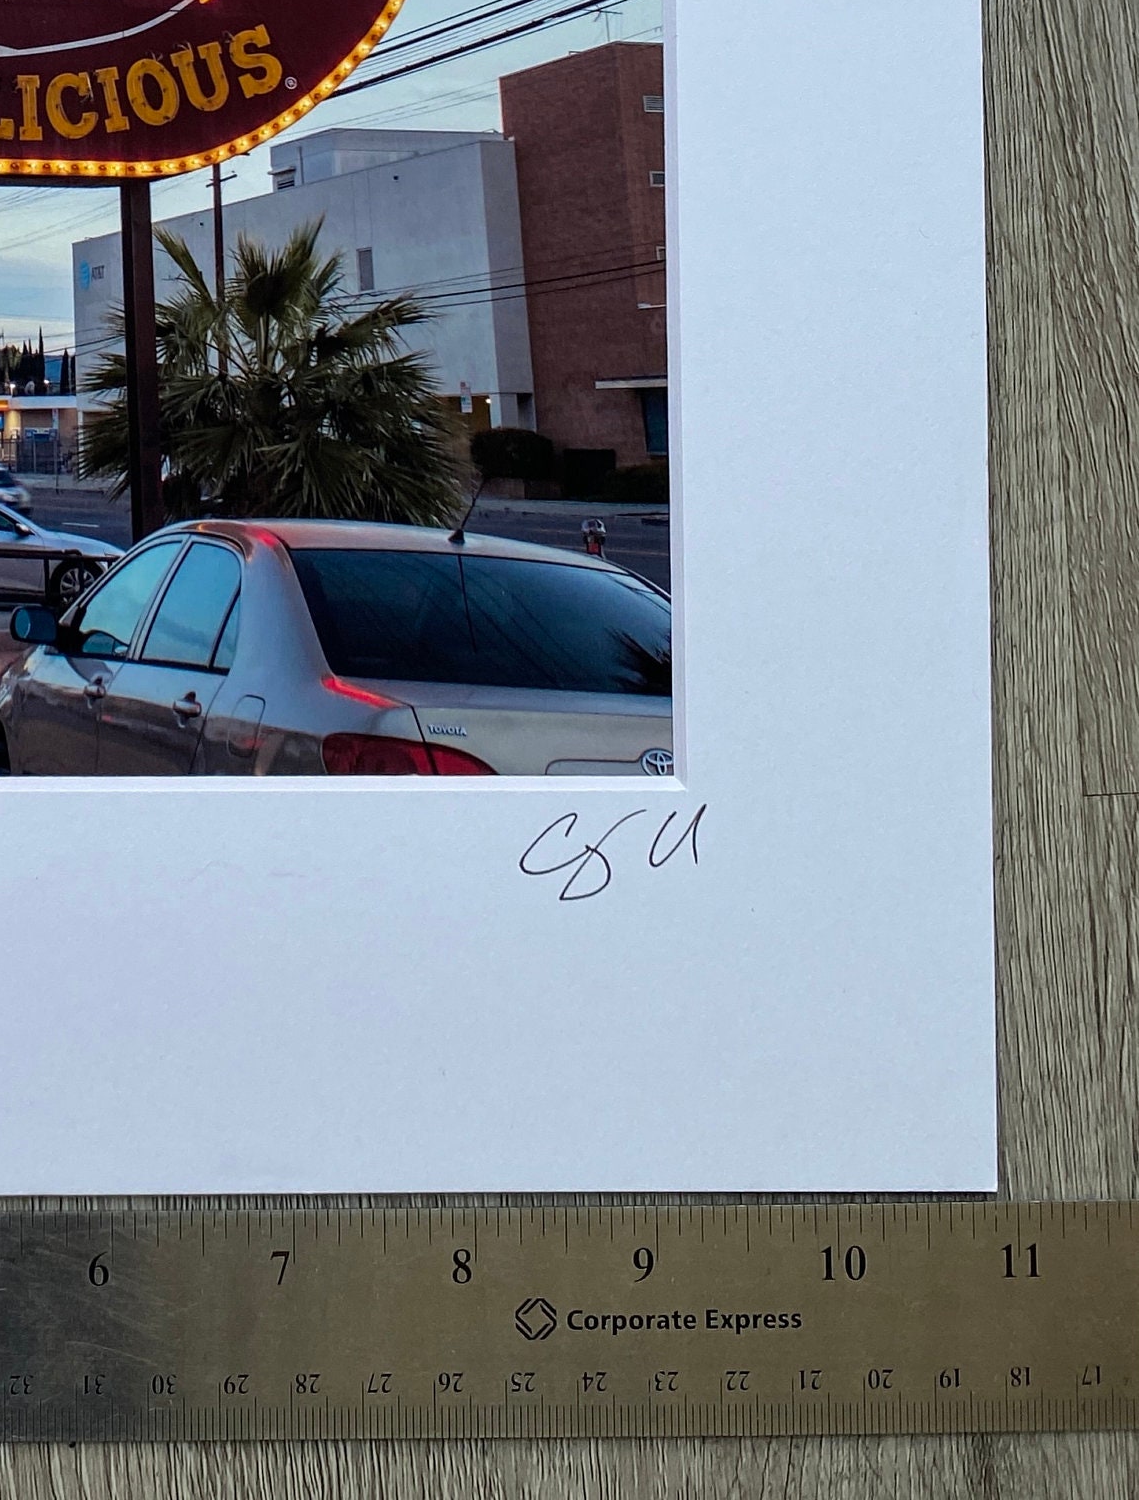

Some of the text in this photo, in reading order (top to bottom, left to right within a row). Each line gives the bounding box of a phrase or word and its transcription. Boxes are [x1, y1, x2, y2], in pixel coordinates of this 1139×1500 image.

[428, 724, 467, 737] TOYOTA
[88, 1251, 109, 1287] 6
[270, 1251, 289, 1285] 7
[452, 1249, 472, 1284] 8
[633, 1248, 654, 1283] 9
[821, 1245, 867, 1281] 10
[1001, 1243, 1041, 1278] 11
[566, 1309, 802, 1335] Corporate Express
[10, 1375, 34, 1395] 32
[83, 1374, 106, 1395] 31
[152, 1374, 177, 1394] 30
[223, 1374, 250, 1394] 29
[295, 1374, 321, 1394] 28
[367, 1373, 393, 1394] 27
[438, 1372, 464, 1392] 26
[511, 1372, 536, 1392] 25
[582, 1371, 608, 1392] 24
[654, 1371, 679, 1391] 23
[726, 1370, 751, 1391] 22
[799, 1370, 823, 1390] 21
[867, 1369, 894, 1389] 20
[939, 1368, 961, 1388] 19
[1010, 1366, 1031, 1387] 18
[1081, 1365, 1101, 1386] 17
